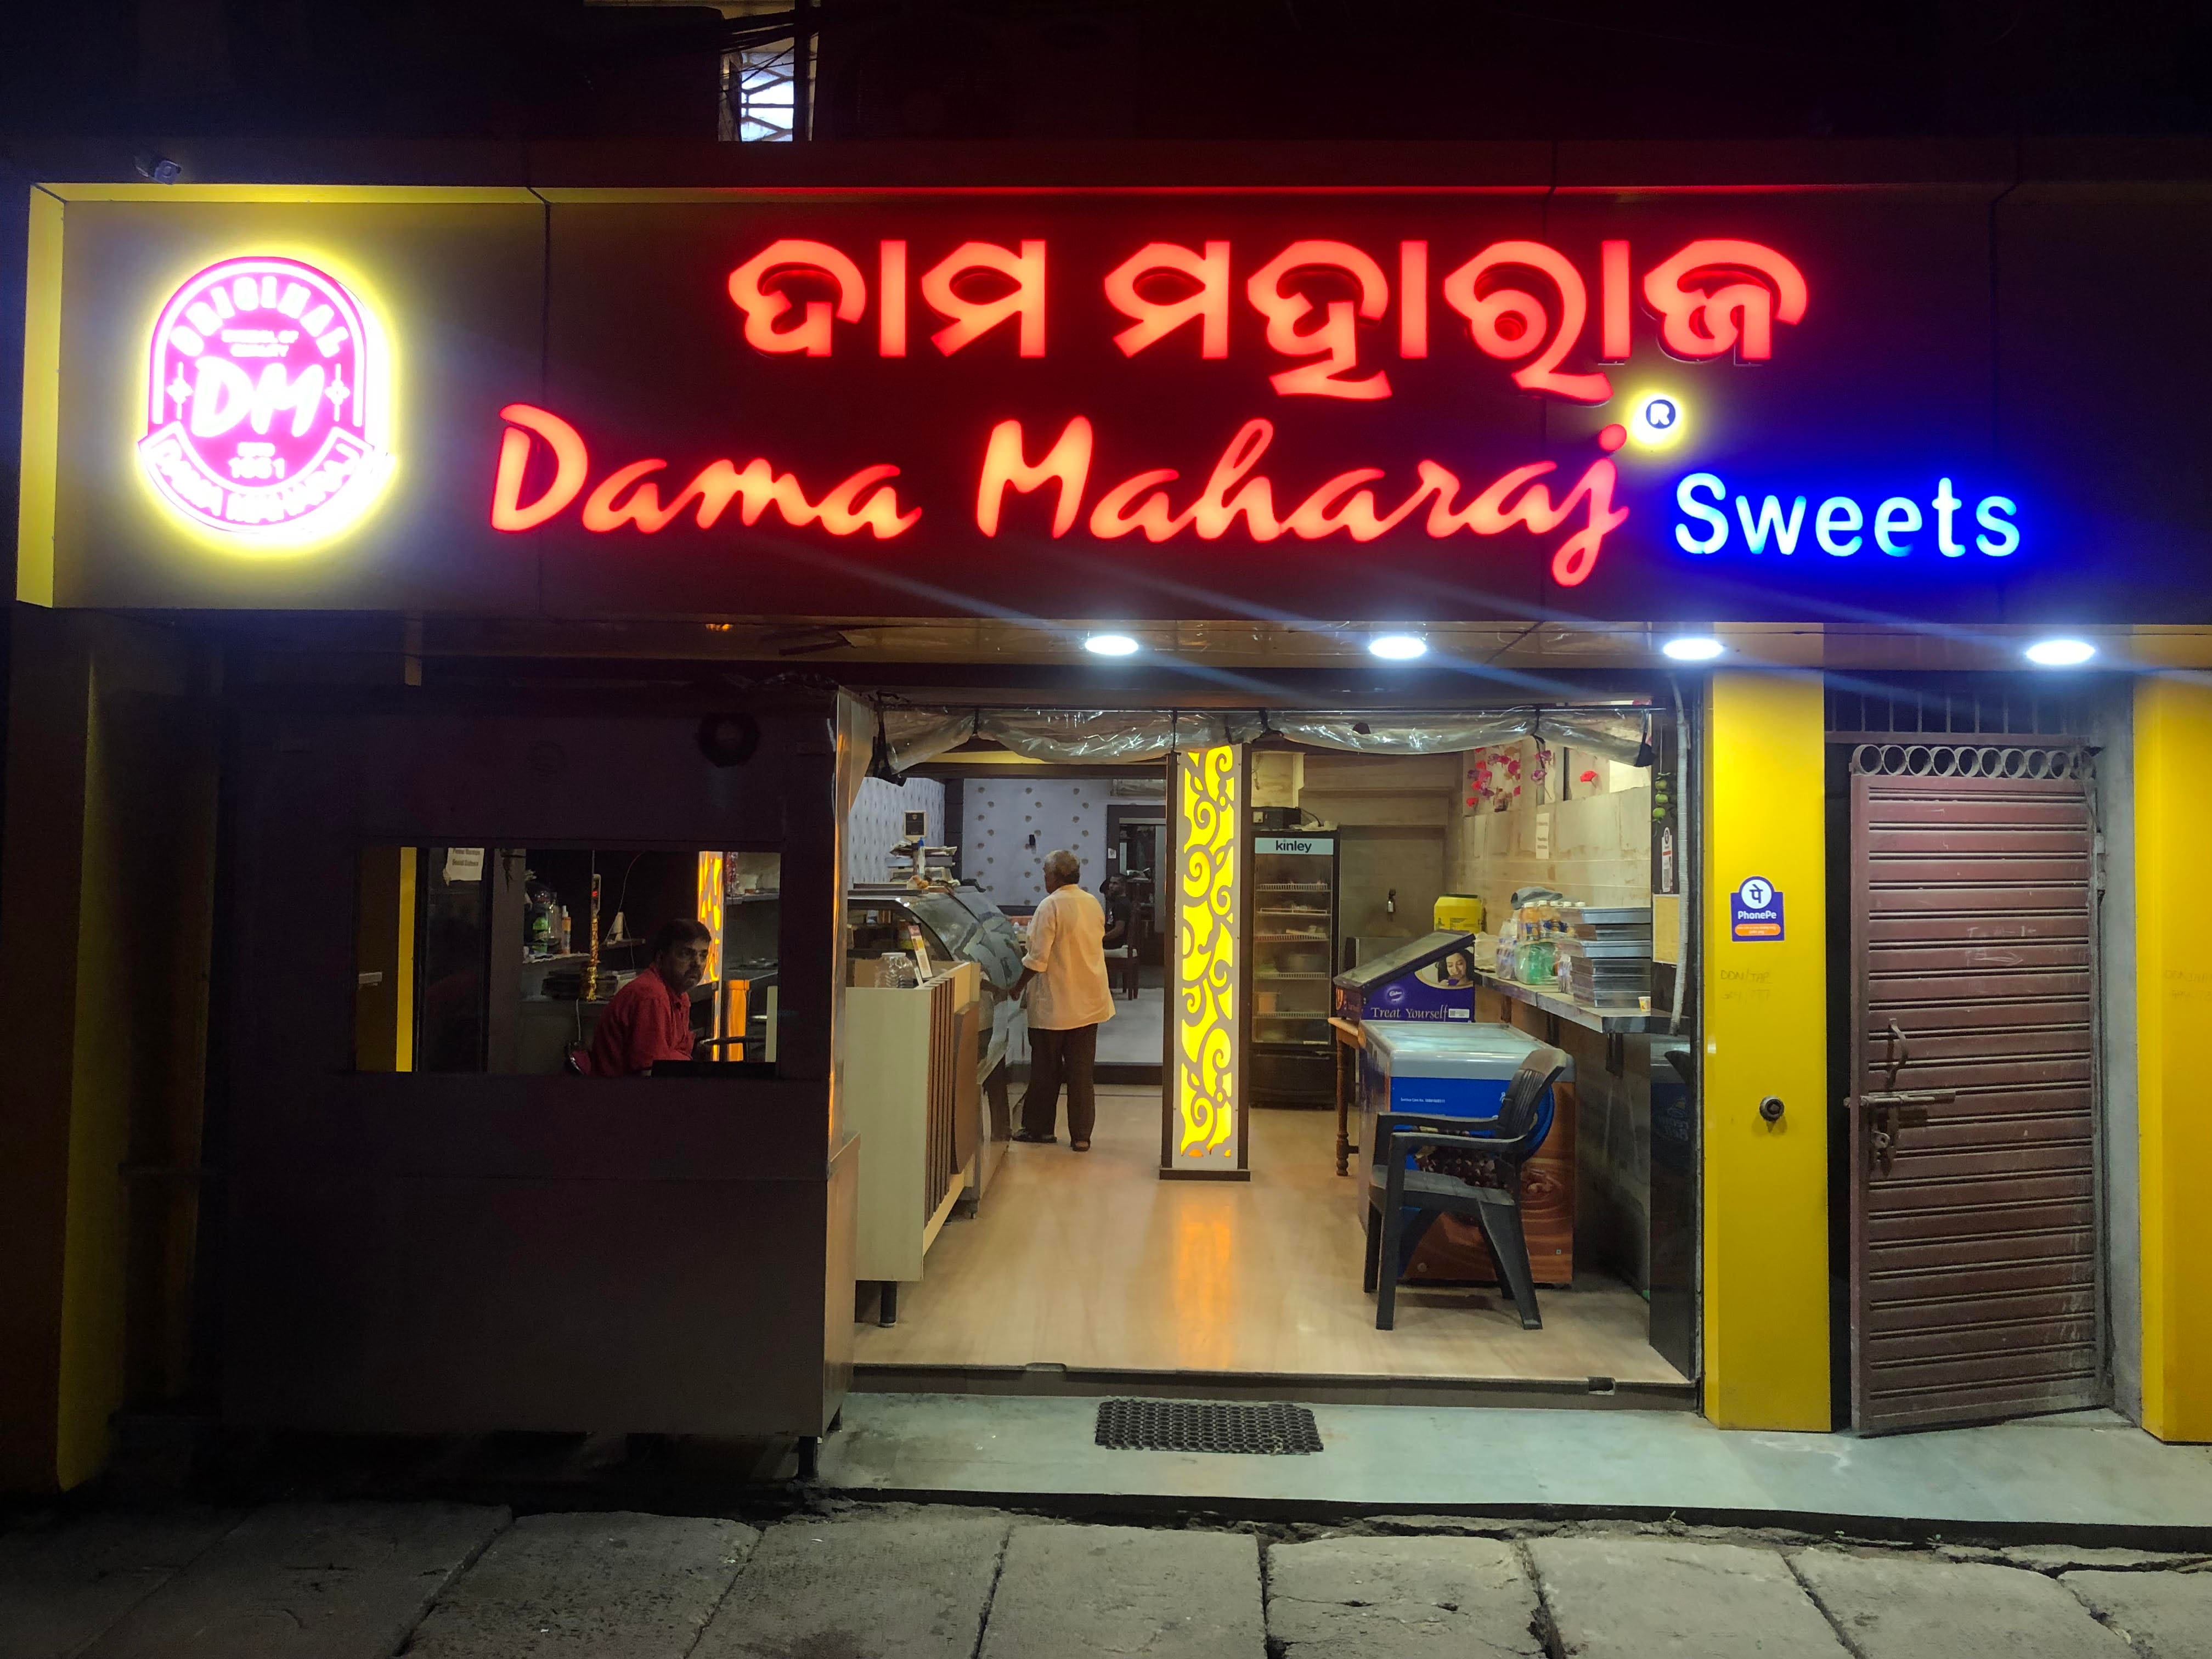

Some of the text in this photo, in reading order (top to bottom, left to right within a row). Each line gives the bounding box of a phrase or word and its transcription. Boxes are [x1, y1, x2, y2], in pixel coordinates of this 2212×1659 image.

[728, 239, 1809, 401] ଦାମ ମହାରାଜ
[191, 356, 326, 438] DM
[491, 404, 922, 539] Dama
[977, 416, 1628, 587] Maharaj
[1675, 472, 2021, 557] Sweets
[1276, 840, 1312, 853] kinley
[1737, 910, 1777, 919] PhonePe
[1372, 1007, 1401, 1018] Treat
[1406, 1005, 1449, 1022] Yourself
